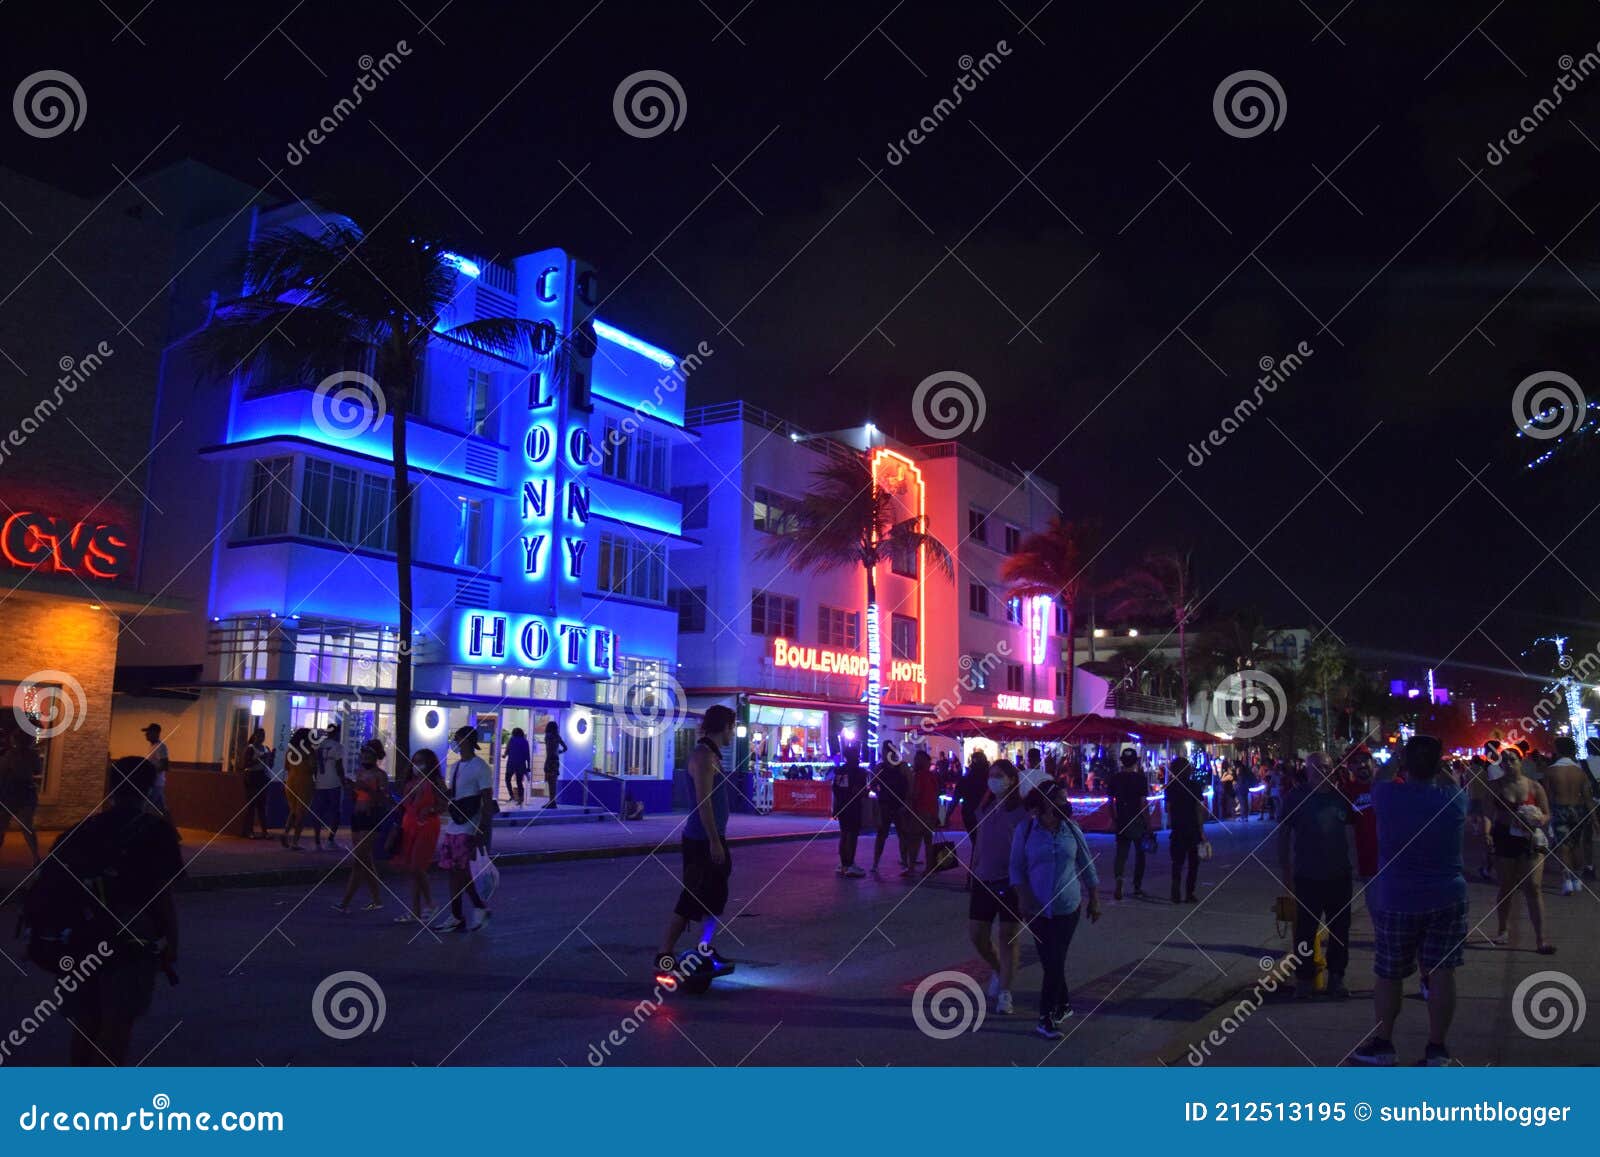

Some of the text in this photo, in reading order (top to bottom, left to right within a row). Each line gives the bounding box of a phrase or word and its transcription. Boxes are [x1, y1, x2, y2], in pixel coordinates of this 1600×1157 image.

[522, 266, 560, 575] COLONY
[1, 511, 131, 579] CVS
[774, 638, 926, 684] BOULEVARD HOTEL
